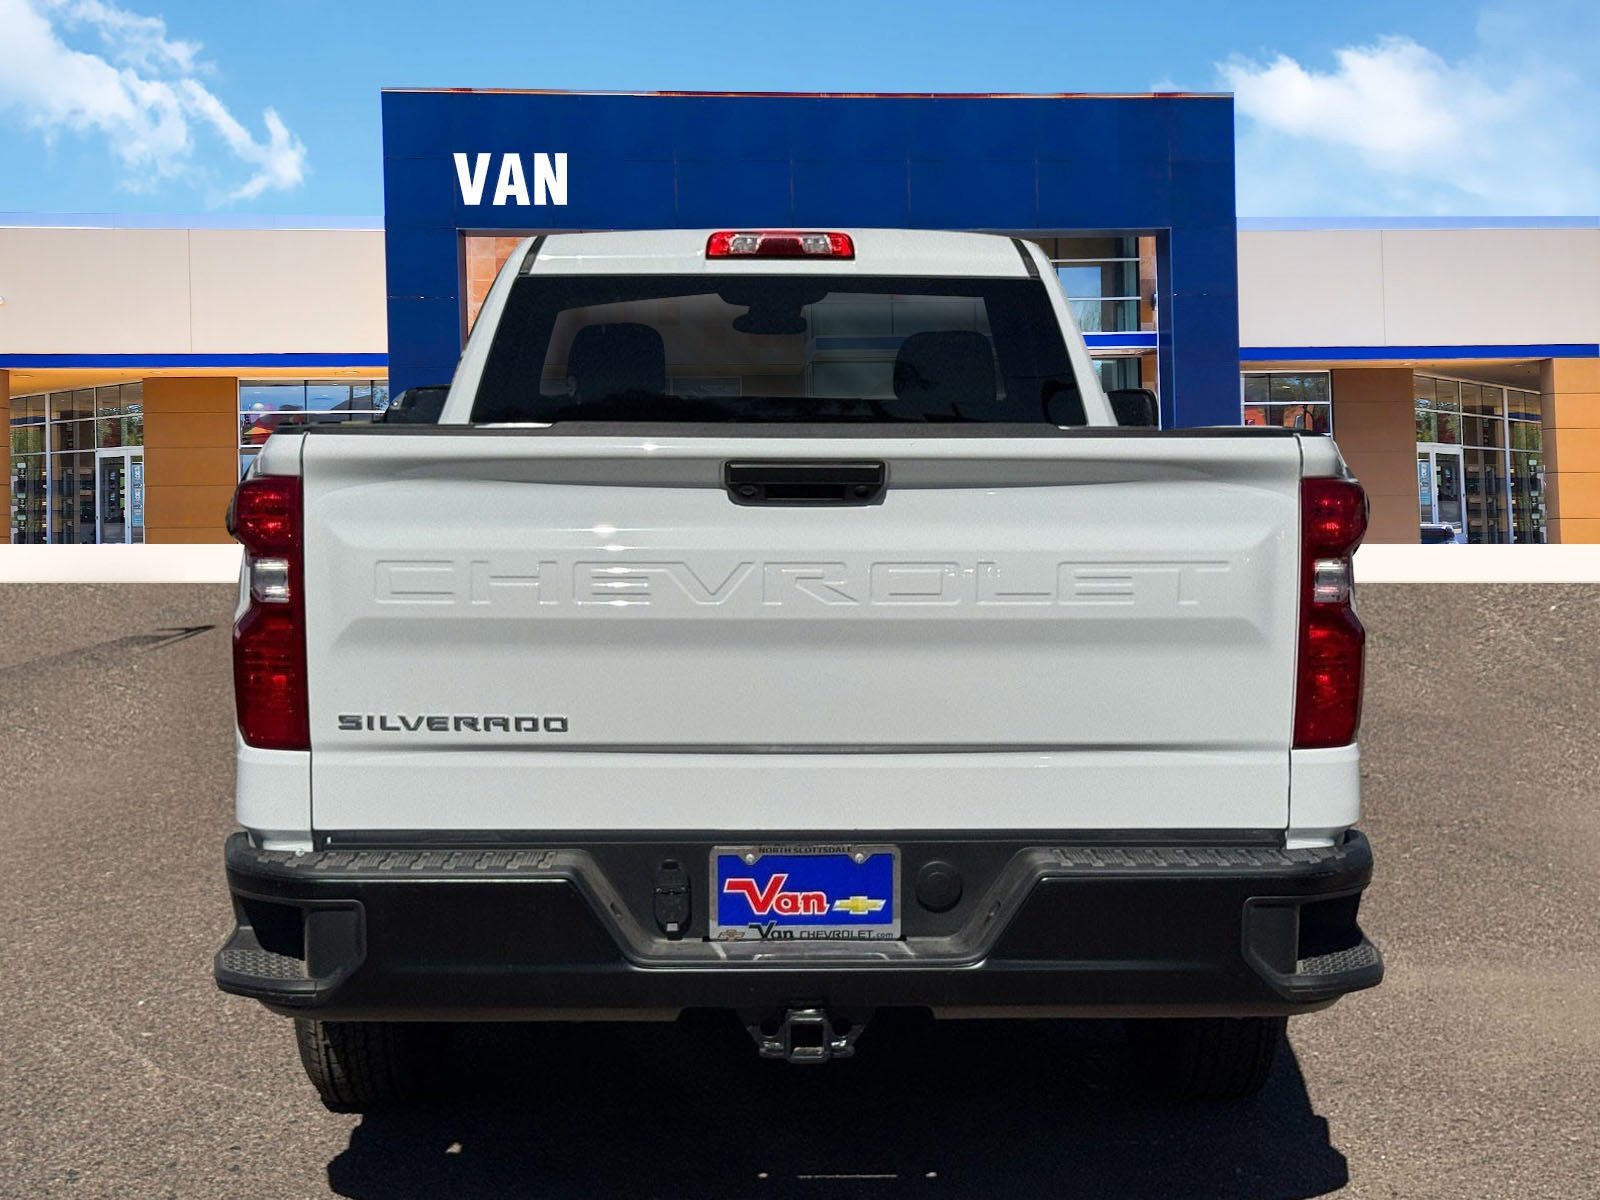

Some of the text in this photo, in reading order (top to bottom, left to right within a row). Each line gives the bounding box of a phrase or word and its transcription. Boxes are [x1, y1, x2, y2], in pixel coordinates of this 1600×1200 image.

[453, 152, 568, 206] VAN
[374, 559, 1231, 607] CHEVROLET
[338, 713, 569, 733] SILVERADO
[759, 846, 791, 854] NORTH
[723, 873, 830, 915] Van
[749, 921, 794, 940] Van
